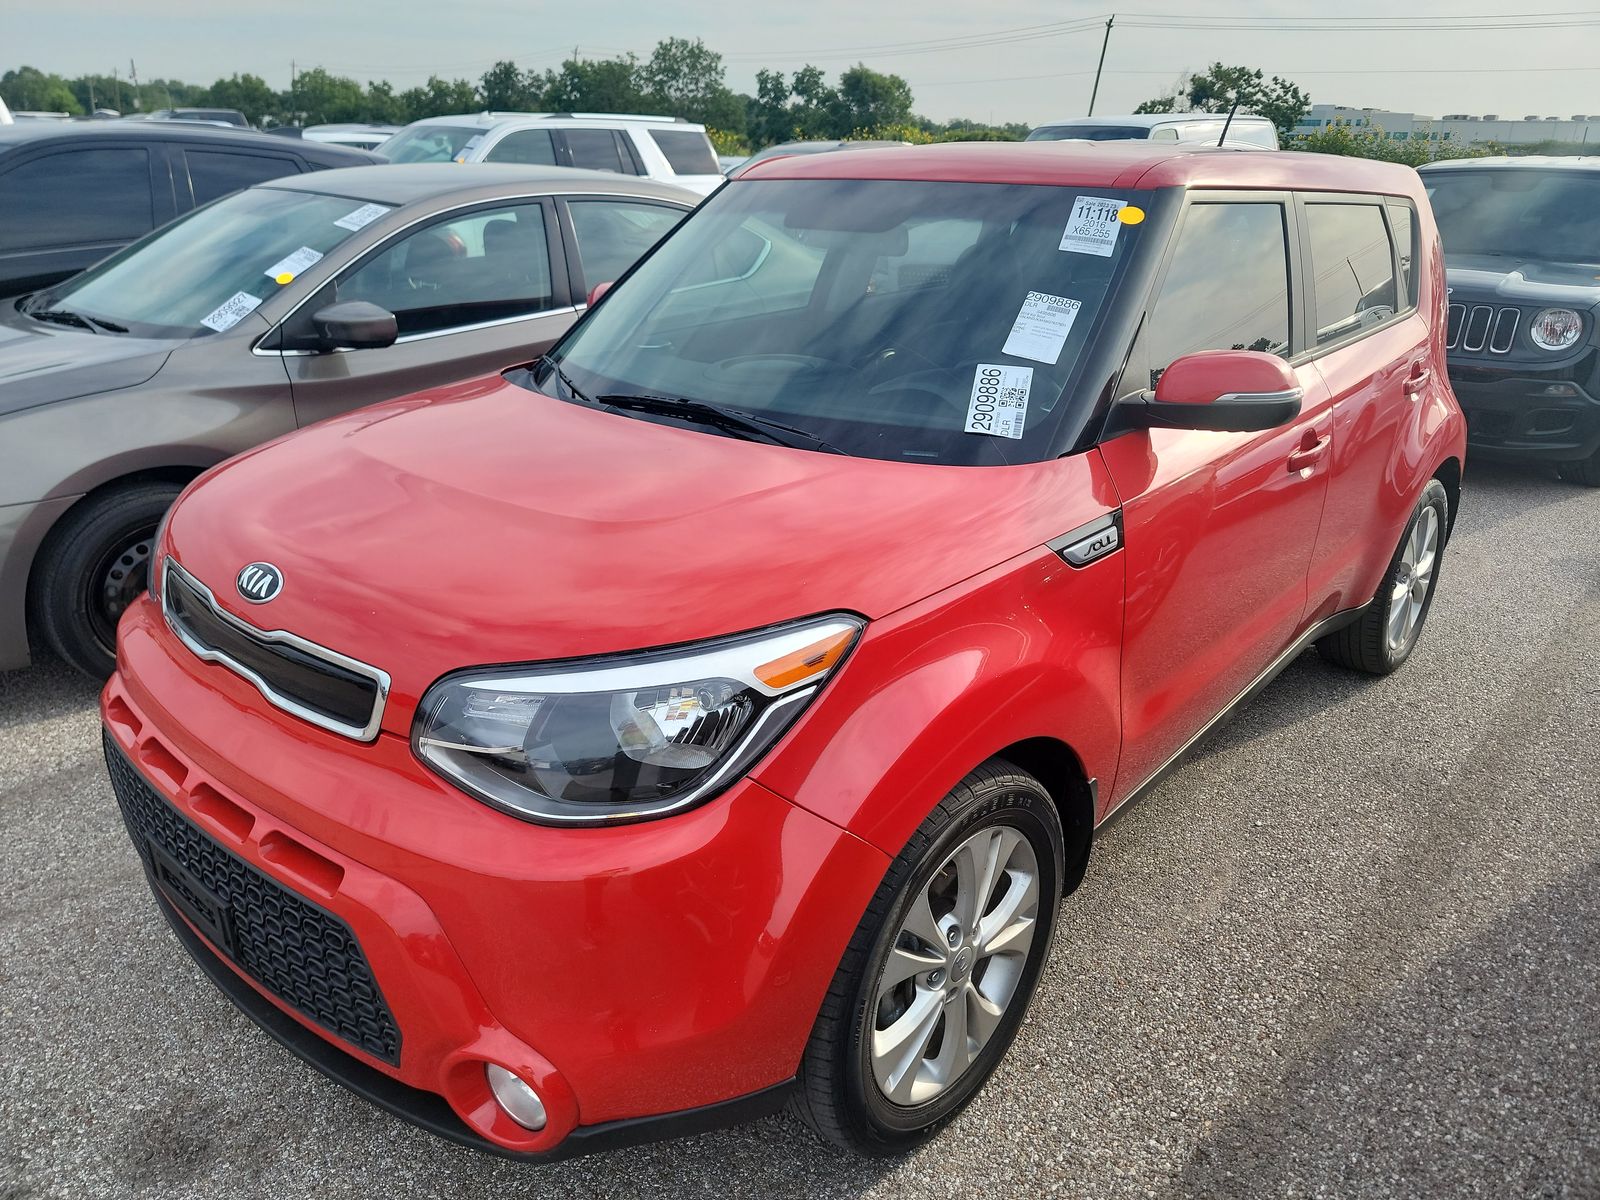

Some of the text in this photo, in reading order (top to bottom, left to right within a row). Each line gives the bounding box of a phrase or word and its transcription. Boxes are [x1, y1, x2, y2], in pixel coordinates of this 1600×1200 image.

[1078, 205, 1118, 222] 11:118
[1072, 225, 1111, 239] X65,255
[1083, 219, 1107, 229] 2016
[1026, 291, 1081, 310] 2909886
[971, 368, 1002, 431] 2909886
[1000, 419, 1011, 436] DLR
[238, 565, 274, 598] KIA
